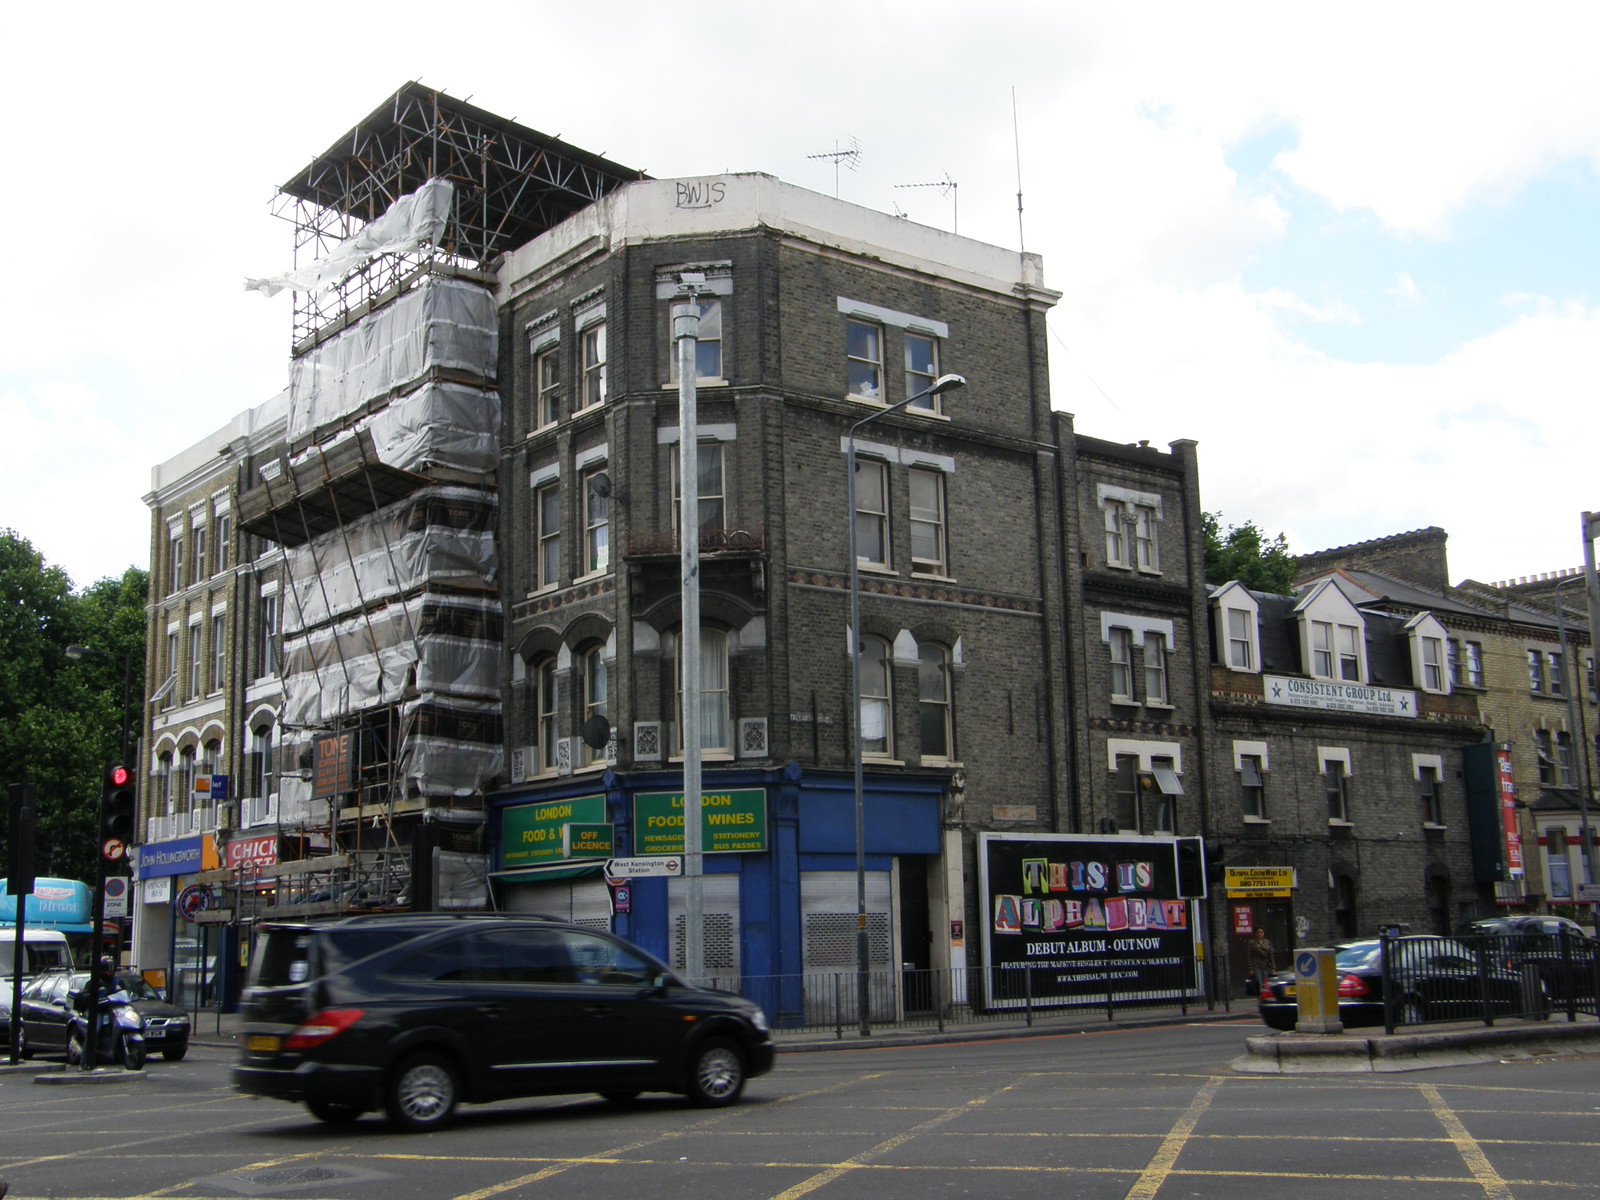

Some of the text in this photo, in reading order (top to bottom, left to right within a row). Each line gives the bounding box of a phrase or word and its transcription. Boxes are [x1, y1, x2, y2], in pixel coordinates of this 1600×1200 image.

[1288, 680, 1394, 702] CONSISTENT GROUP Ltd.
[671, 794, 731, 808] LDON
[535, 804, 572, 821] LONDON
[708, 812, 755, 825] WINES
[522, 829, 546, 843] FOOD
[549, 828, 555, 840] &
[580, 831, 599, 840] OFF
[644, 831, 760, 843] NEWSAGE STATIONERY
[571, 841, 611, 851] LICENCE
[645, 841, 761, 852] GROCERIE BUS PASSES
[140, 854, 156, 868] JOHN
[630, 860, 665, 868] Kensington
[1022, 857, 1154, 894] THIS IS
[994, 895, 1187, 934] ALPHABEAT
[1026, 942, 1065, 955] DEBUT
[1067, 940, 1106, 953] ALBUM
[1113, 938, 1135, 951] OUT
[1136, 937, 1161, 950] NOW
